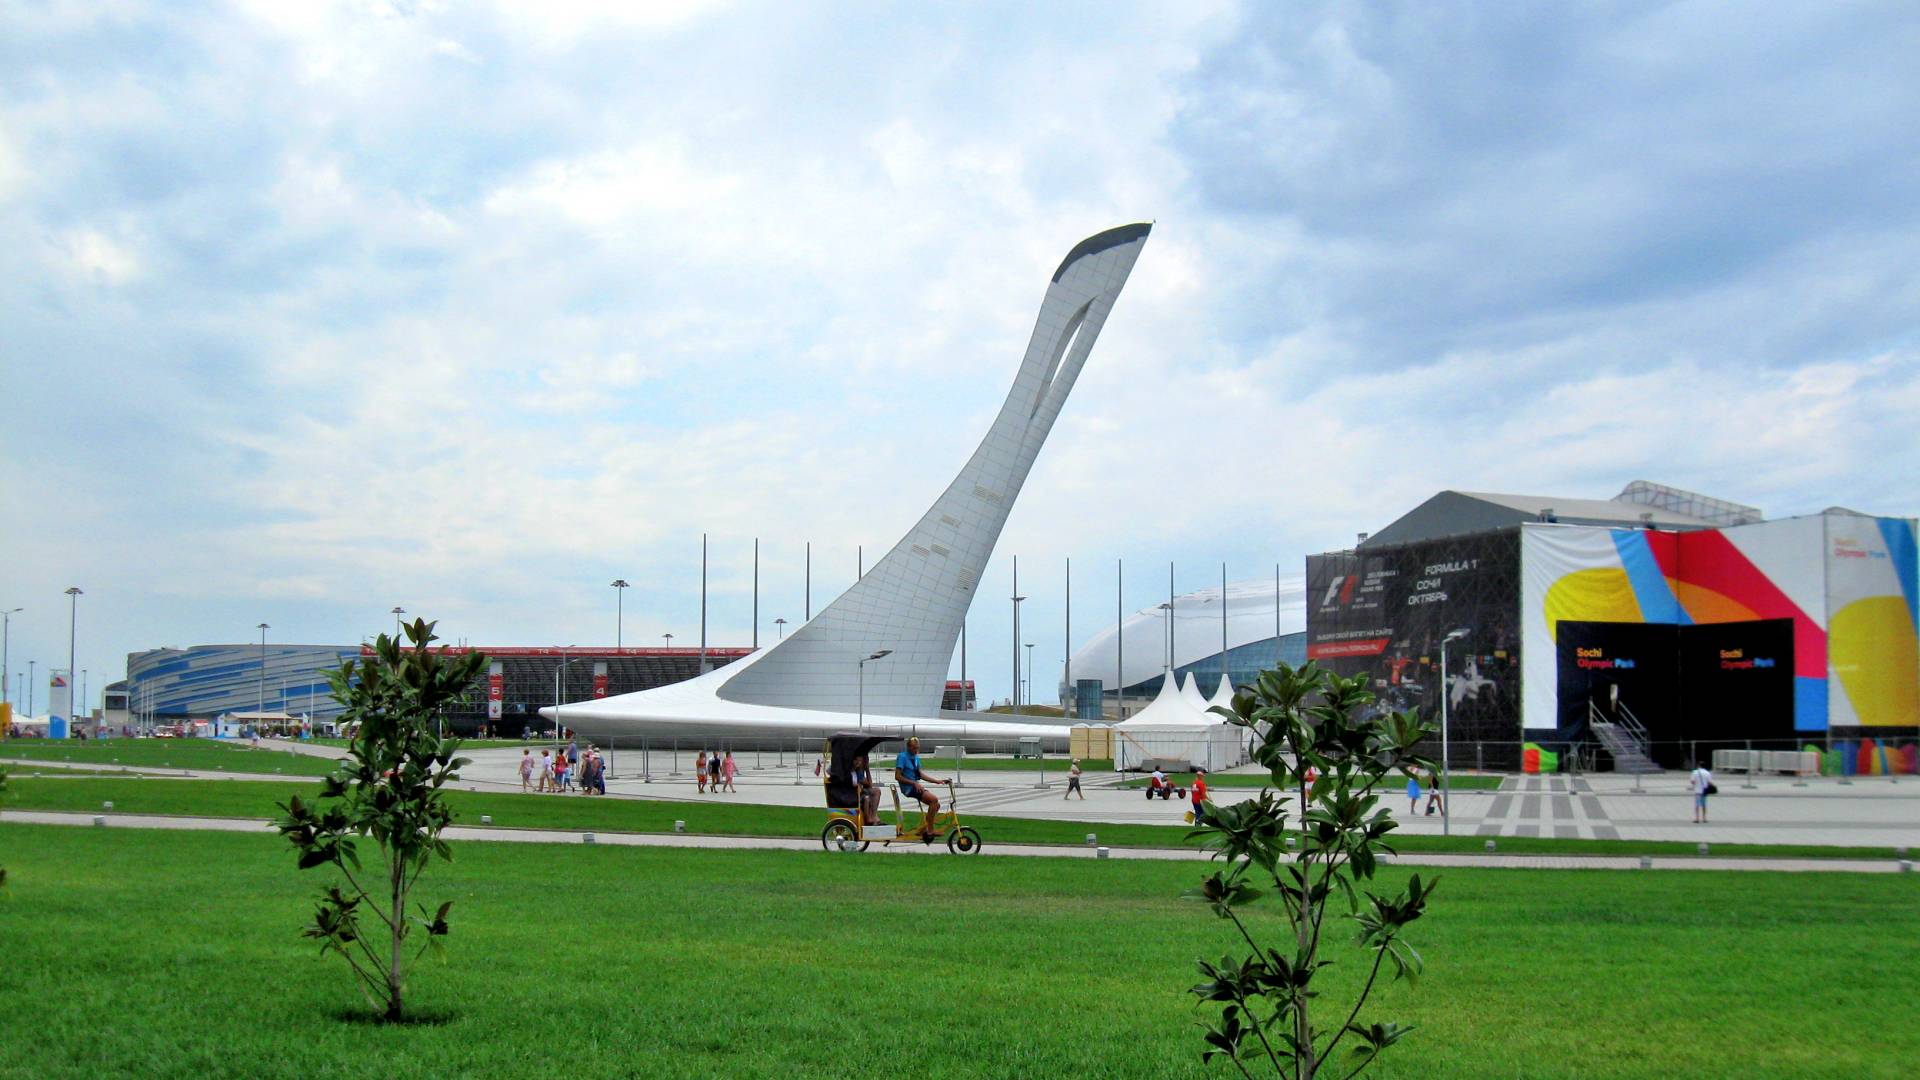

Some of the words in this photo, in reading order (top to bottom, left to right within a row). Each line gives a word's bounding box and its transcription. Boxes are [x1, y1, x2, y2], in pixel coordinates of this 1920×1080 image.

[1425, 560, 1469, 576] FORMULA
[1416, 578, 1441, 590] СОЧИ
[1408, 591, 1448, 605] ОКТЯБРЬ
[1577, 647, 1602, 657] Sochi
[1720, 648, 1743, 659] Sochi
[1577, 658, 1613, 670] Olympic
[1614, 658, 1636, 668] Park
[1720, 659, 1753, 670] Olympic
[1753, 657, 1776, 668] Park
[491, 687, 500, 695] 5
[596, 687, 605, 695] 4
